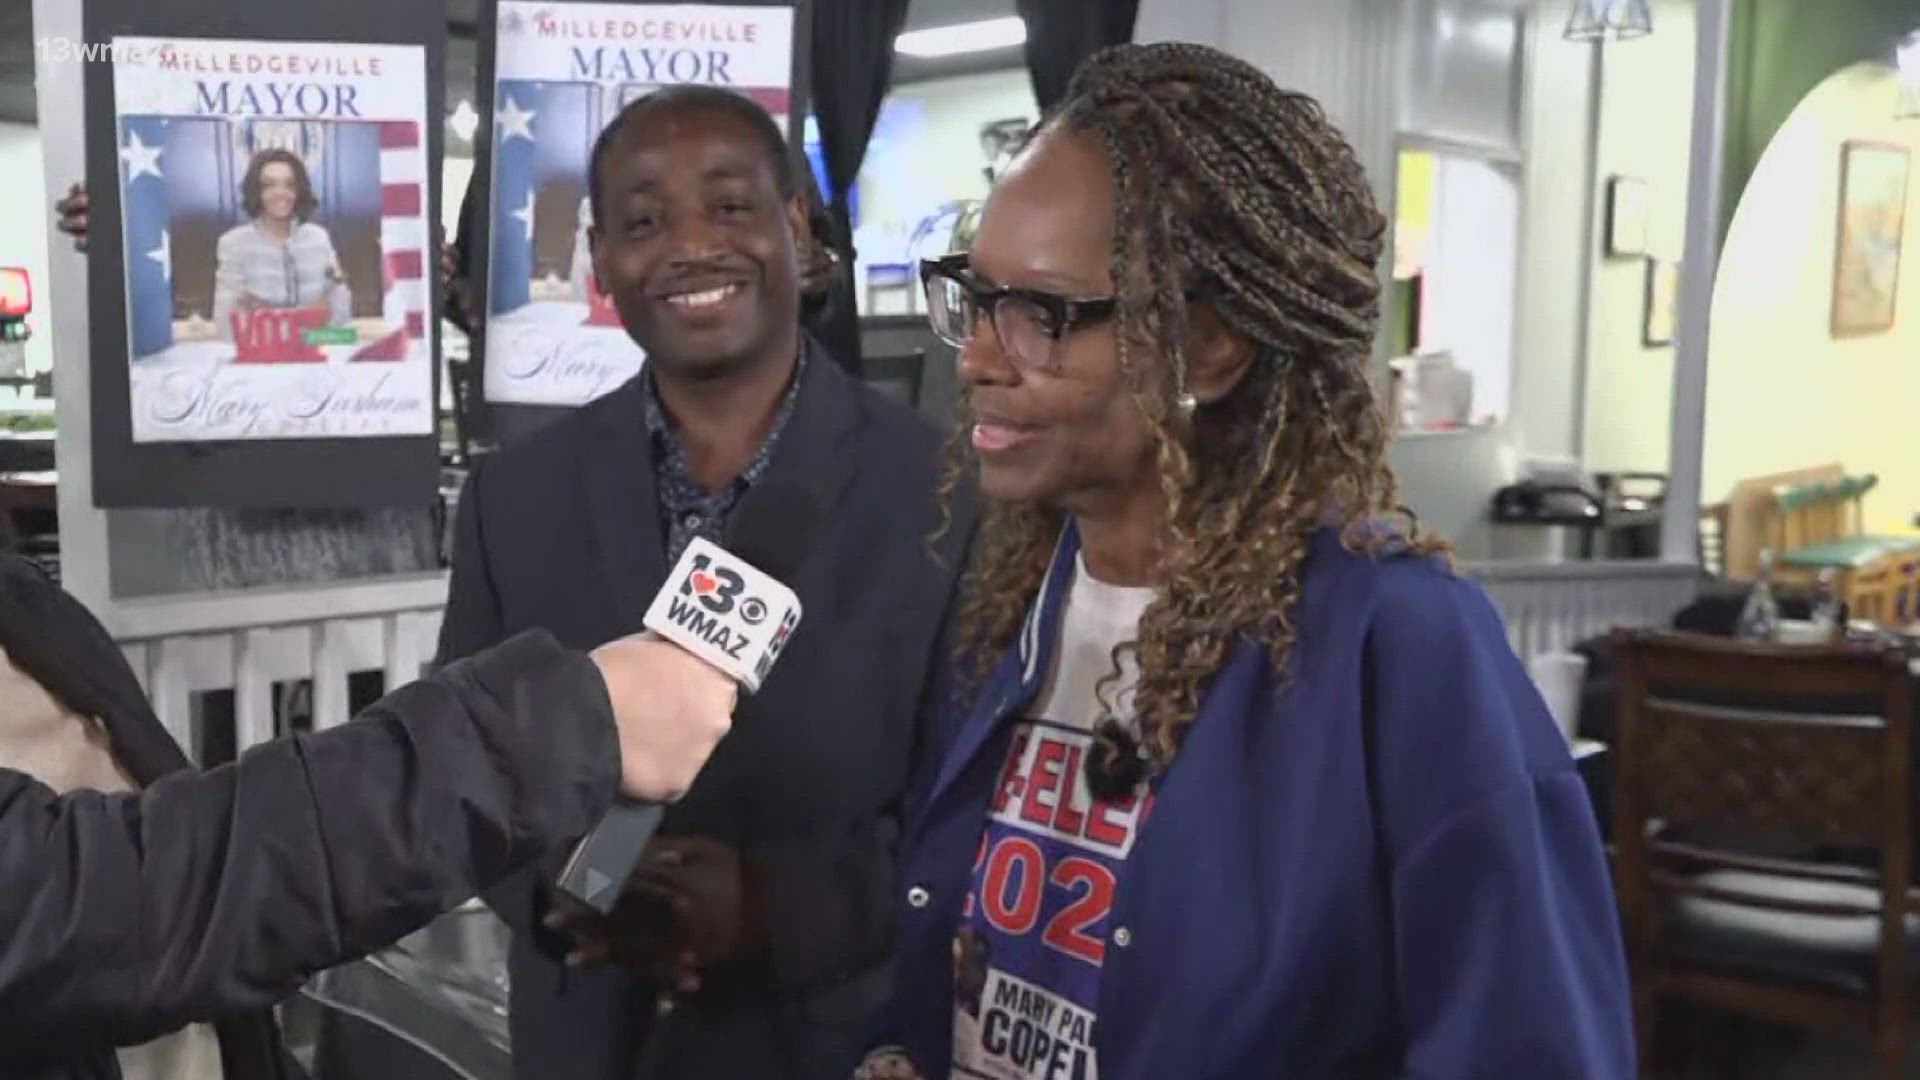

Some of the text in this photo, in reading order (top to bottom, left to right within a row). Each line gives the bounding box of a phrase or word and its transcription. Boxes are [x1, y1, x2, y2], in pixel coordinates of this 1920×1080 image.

[537, 20, 758, 43] MILLEDGEVILLE
[160, 50, 383, 76] MILLEDGEVILLE
[570, 46, 732, 83] MAYOR
[194, 81, 362, 117] MAYOR
[666, 595, 750, 661] WMAZ
[994, 977, 1058, 1026] MARY
